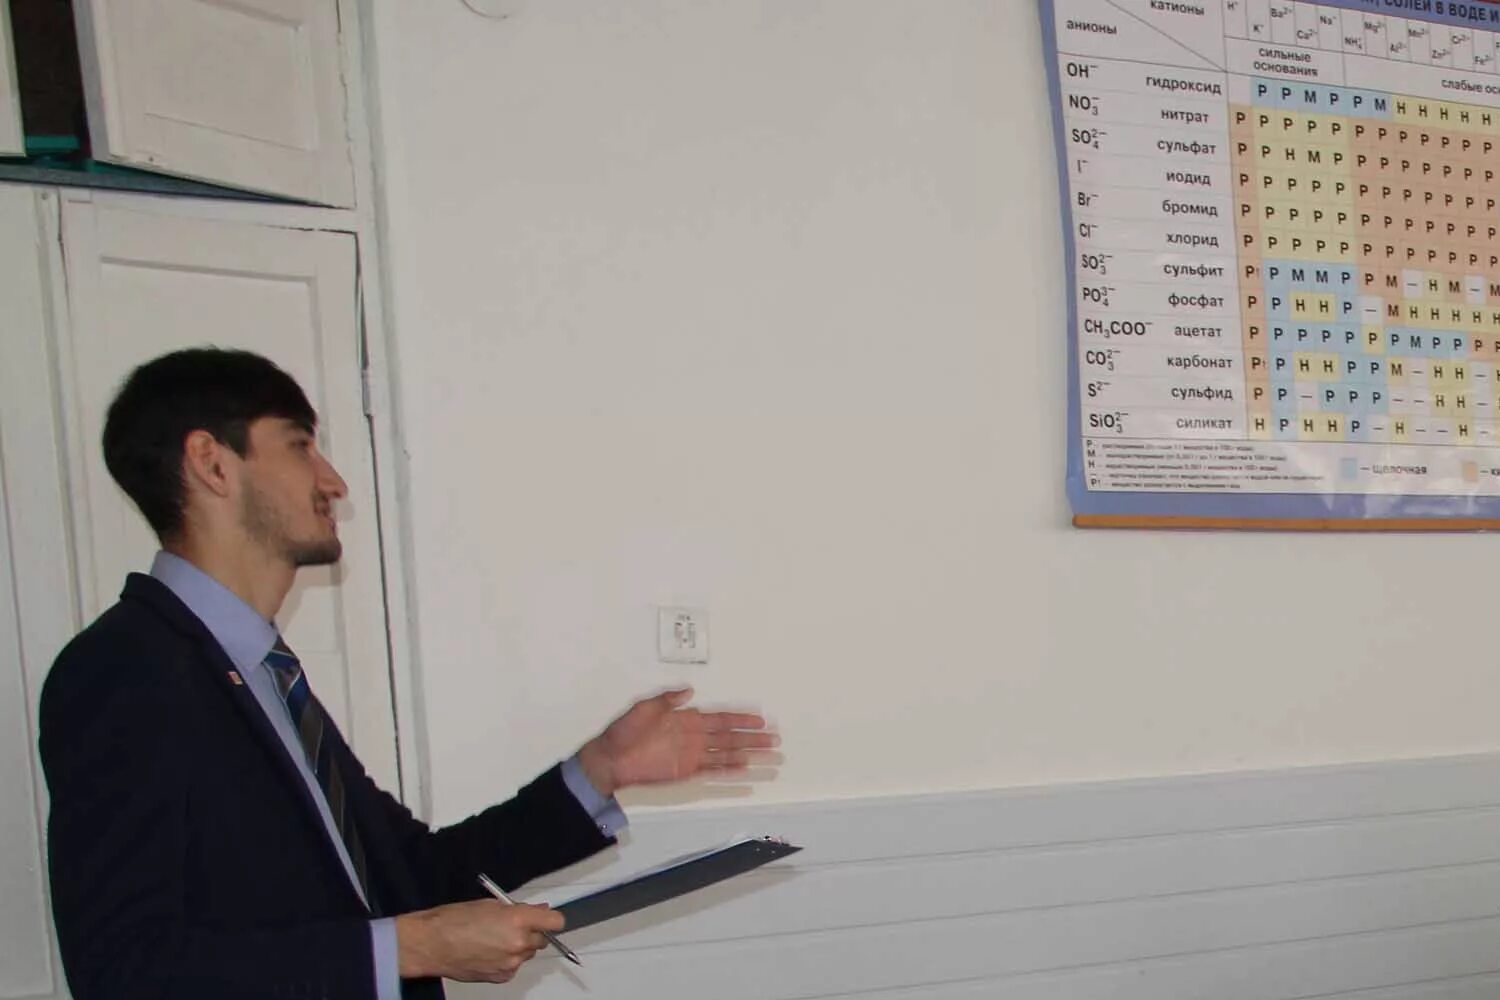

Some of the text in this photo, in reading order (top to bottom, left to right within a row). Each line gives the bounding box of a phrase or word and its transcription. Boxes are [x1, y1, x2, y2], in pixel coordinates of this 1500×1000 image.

[1151, 0, 1205, 16] катионы
[1436, 1, 1445, 15] В
[1449, 3, 1487, 21] ВОДЕ
[1489, 9, 1500, 23] И
[1066, 20, 1117, 35] анионы
[1258, 47, 1312, 63] сильные
[1253, 60, 1318, 77] основания
[1441, 79, 1483, 94] слабые
[1146, 77, 1221, 95] гидроксид
[1258, 84, 1267, 96] Р
[1282, 87, 1291, 99] Р
[1305, 90, 1316, 103] М
[1330, 93, 1338, 105] Р
[1353, 96, 1362, 108] Р
[1375, 98, 1386, 110] М
[1397, 102, 1405, 114] Н
[1419, 105, 1427, 117] Н
[1440, 108, 1448, 119] Н
[1461, 112, 1469, 122] Н
[1482, 114, 1491, 125] Н
[1161, 110, 1386, 139] нитрат Р Р Р Р Р Р Р
[1157, 140, 1388, 168] сульфат Р Р Н М Р Р Р
[1166, 173, 1391, 198] иодид Р Р Р Р Р Р Р
[1162, 200, 1392, 227] бромид Р Р Р Р Р Р Р
[1167, 234, 1394, 257] хлорид Р Р Р Р Р Р Р
[1164, 264, 1397, 287] сульфит Р Р М М Р Р М
[1168, 293, 1399, 316] фосфат Р Р Н Н Р М
[1175, 326, 1399, 345] ацетат Р Р Р Р Р Р Р
[1167, 355, 1402, 375] карбонат Р Р Н Н Р Р М
[1171, 386, 1381, 404] сульфид Р Р Р Р Р
[1176, 418, 1404, 434] силикат Н Р Н Н Р Н
